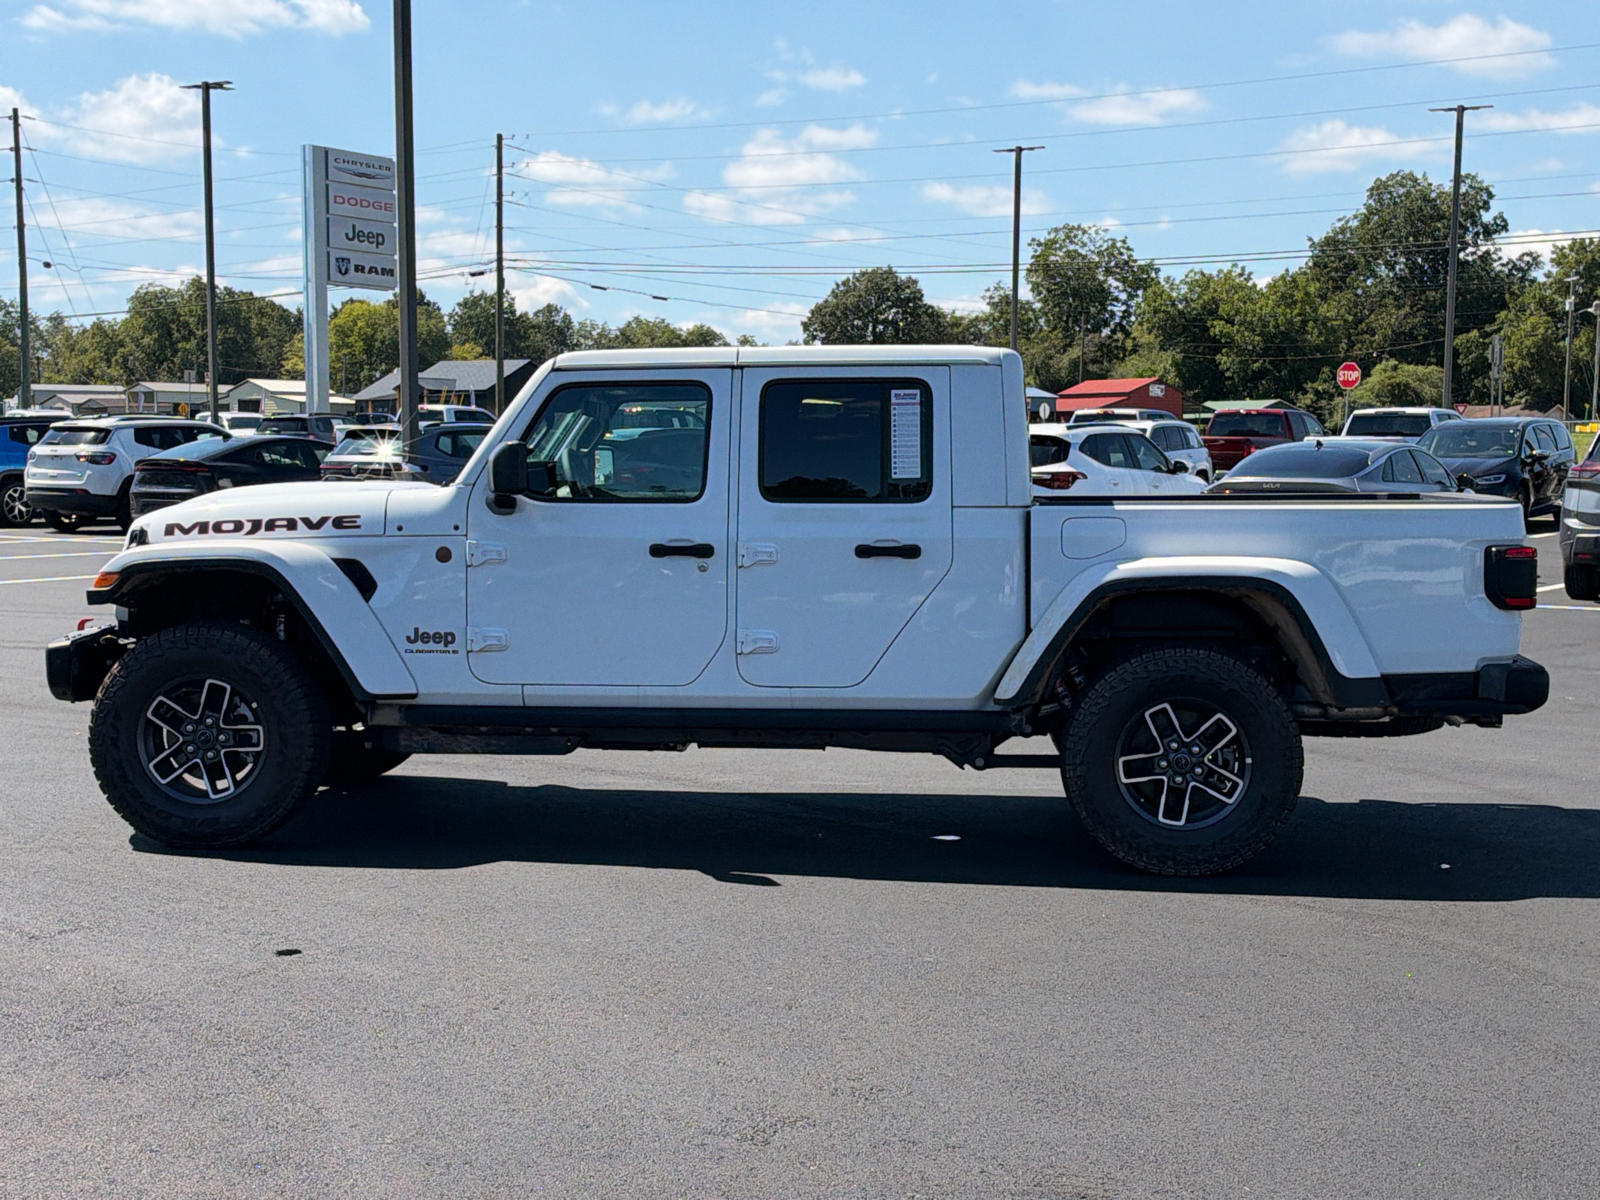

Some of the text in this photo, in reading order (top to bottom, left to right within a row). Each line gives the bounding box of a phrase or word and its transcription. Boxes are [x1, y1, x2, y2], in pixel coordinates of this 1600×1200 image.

[333, 157, 391, 172] CHRYSLER
[333, 195, 393, 212] DODGE
[345, 224, 385, 248] Jeep
[354, 264, 394, 277] RAM
[1338, 370, 1359, 381] STOP
[164, 514, 361, 536] MOJAVE
[406, 627, 456, 648] Jeep
